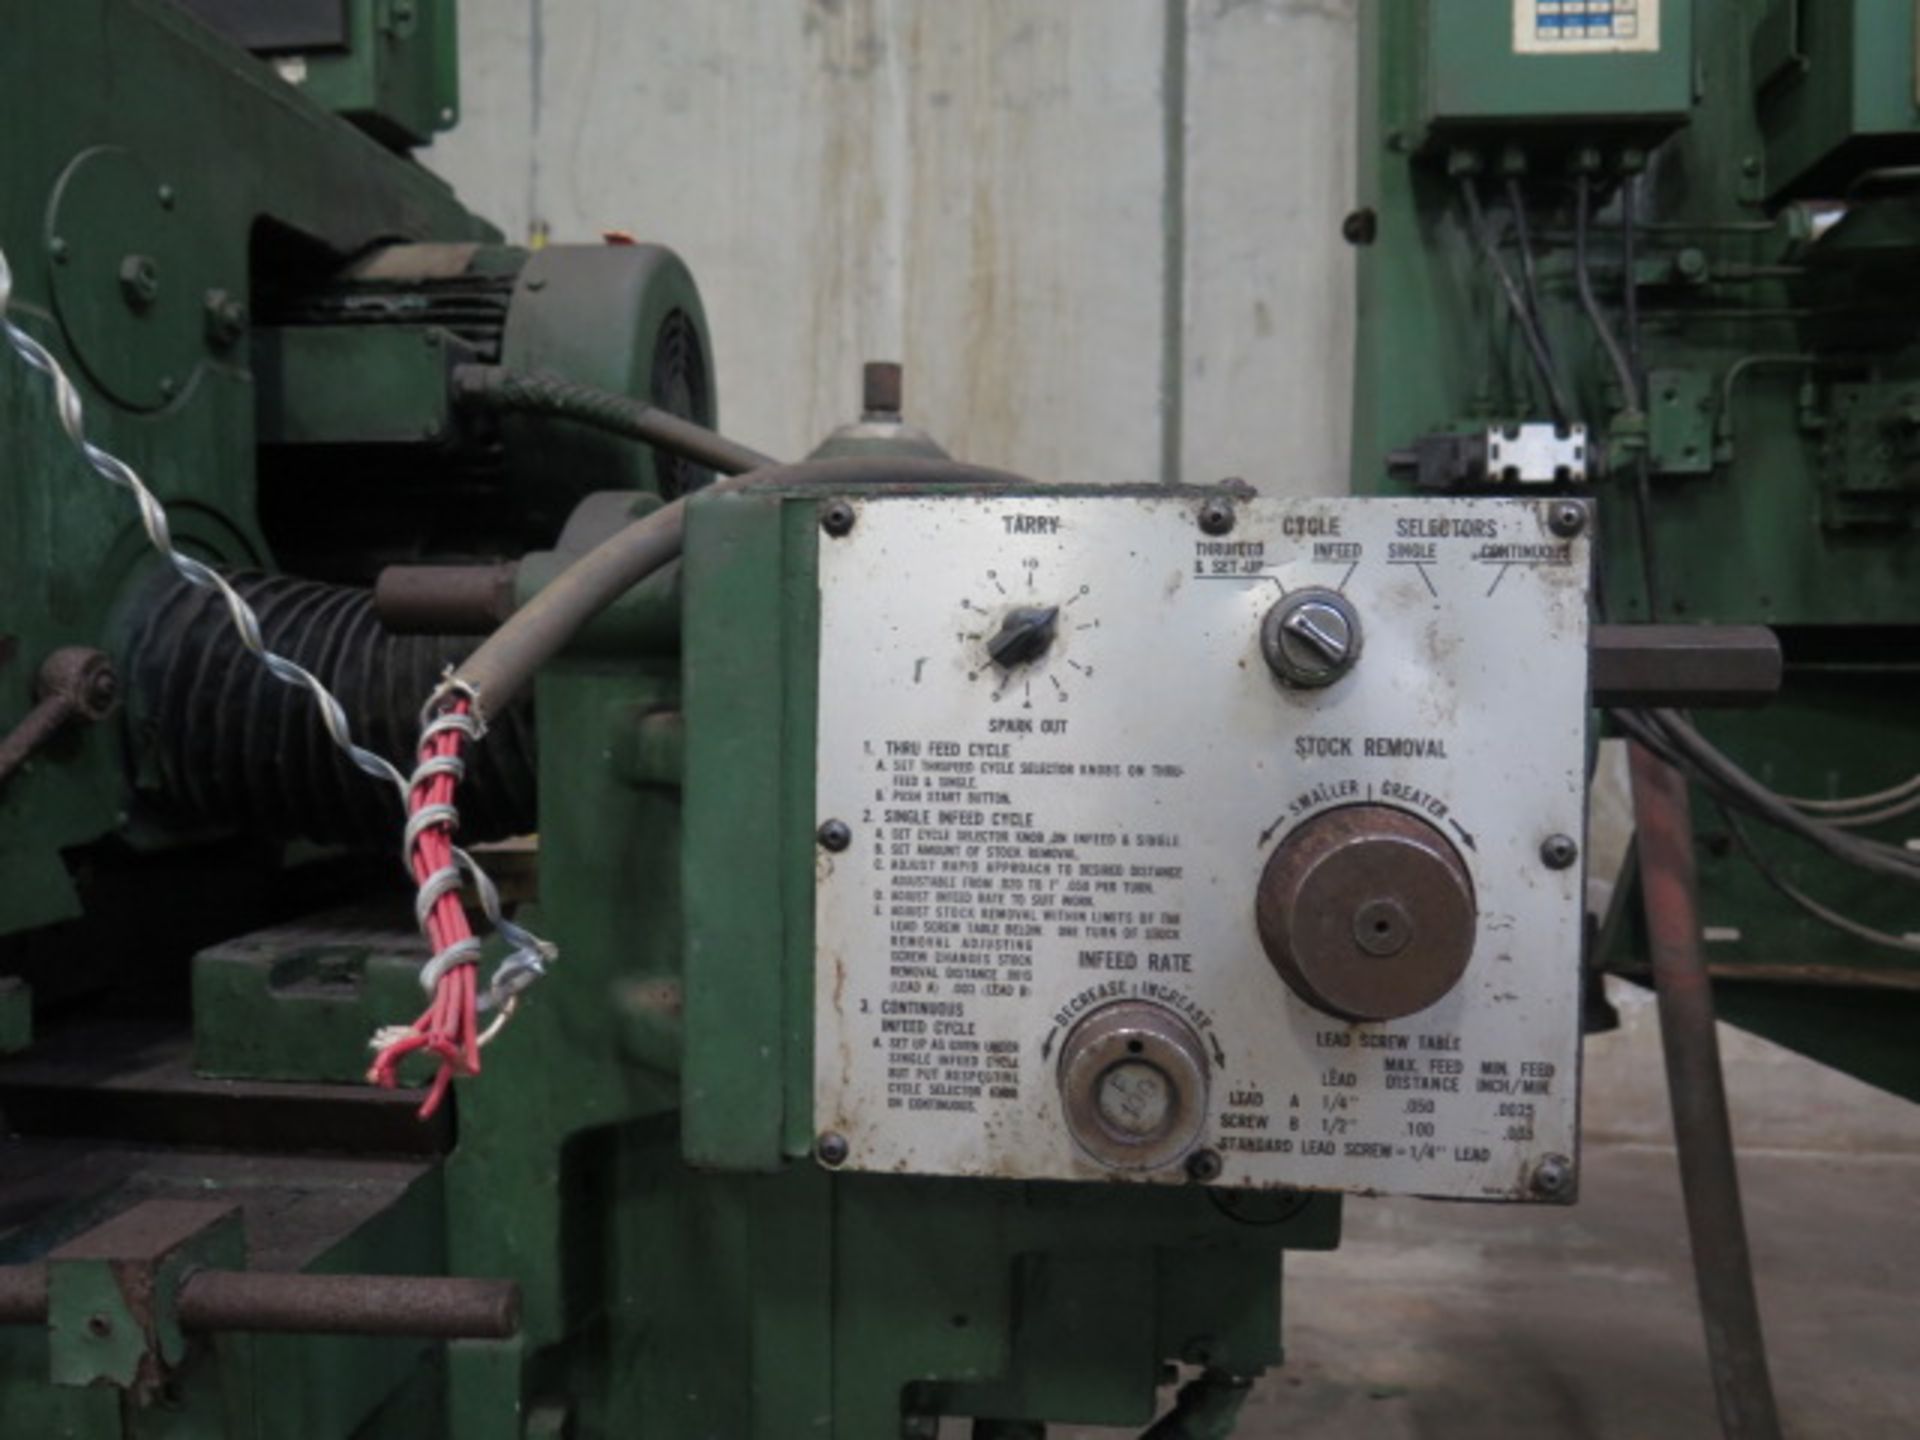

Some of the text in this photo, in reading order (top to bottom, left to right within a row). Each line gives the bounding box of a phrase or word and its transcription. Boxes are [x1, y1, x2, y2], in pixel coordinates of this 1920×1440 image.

[1002, 515, 1061, 534] TARRY
[1282, 516, 1497, 538] CYCLE SELECTORS
[1314, 542, 1362, 559] INFEED
[1388, 543, 1436, 558] SINGLE
[1022, 558, 1039, 570] 10
[1212, 559, 1264, 574] SET-UP
[1079, 585, 1090, 595] 0
[1085, 666, 1094, 677] 2
[989, 719, 1068, 734] SPARK OUT
[885, 741, 921, 756] THRU
[928, 741, 961, 757] FEED
[968, 742, 1010, 758] CYCLE
[1295, 737, 1447, 758] STOCK REMOVAL
[980, 762, 1015, 774] CYCLE
[1128, 764, 1145, 777] ON
[892, 789, 922, 802] PUSH
[927, 791, 961, 802] START
[1289, 779, 1450, 820] SMALLER GREATER
[884, 809, 930, 824] SINGLE
[938, 810, 984, 826] INFEED
[991, 812, 1033, 828] CYCLE
[986, 846, 1022, 859] STOCK
[890, 859, 935, 871] ADJUST
[1095, 881, 1117, 893] PER
[1031, 894, 1056, 906] SUIT
[935, 906, 975, 919] STOCK
[981, 908, 1037, 921] REMOVAL
[890, 936, 1033, 951] REMOVAL ADJUSTING
[1078, 950, 1192, 973] INFEED RATE
[881, 1000, 964, 1017] CONTINUOUS
[1055, 978, 1213, 1029] DECREASE INCREASE
[881, 1019, 975, 1036] INFEED CYCLE
[912, 1038, 928, 1050] UP
[1316, 1031, 1461, 1051] LEAD SCREW TABLE
[1429, 1058, 1464, 1074] FEED
[1520, 1062, 1556, 1078] FEED
[1322, 1072, 1357, 1088] LEAD
[1386, 1075, 1459, 1092] DISTANCE
[1229, 1091, 1264, 1107] LEAD
[1289, 1094, 1300, 1108] A
[1220, 1115, 1269, 1129] SCREW
[1289, 1117, 1299, 1131] B
[1218, 1137, 1293, 1153] STANDARD
[1301, 1140, 1336, 1156] LEAD
[1344, 1142, 1393, 1158] SCREW
[1454, 1147, 1491, 1163] LEAD
